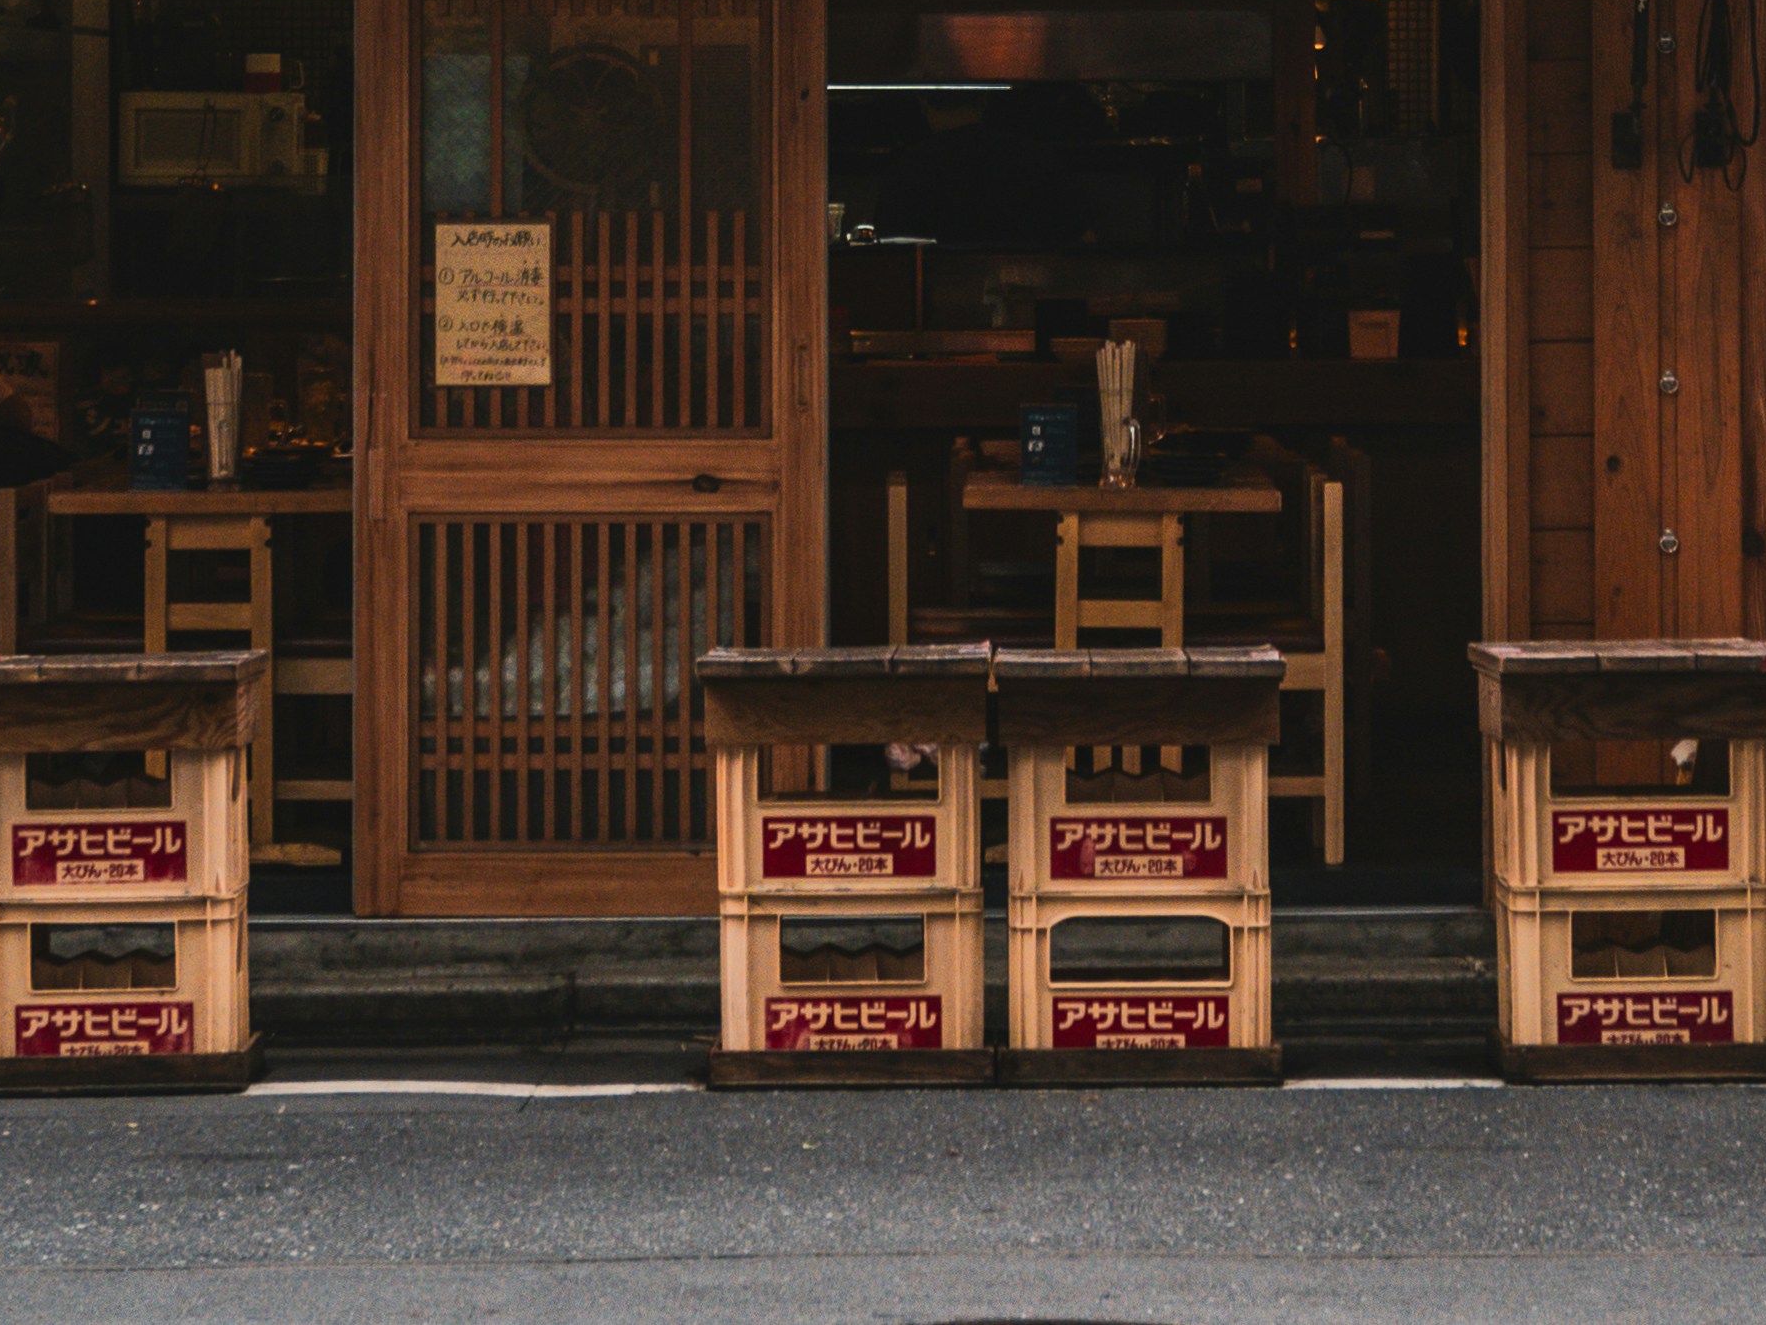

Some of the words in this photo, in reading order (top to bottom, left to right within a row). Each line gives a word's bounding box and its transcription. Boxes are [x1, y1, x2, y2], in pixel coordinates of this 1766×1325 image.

[17, 826, 182, 856] アサヒビール
[767, 820, 932, 850] アサヒビール
[1054, 820, 1223, 850] アサヒビール
[1556, 813, 1724, 844] アサヒビール
[20, 1008, 190, 1038] アサヒビール
[769, 1001, 938, 1030] アサヒビール
[1057, 1000, 1226, 1030] アサヒビール
[1561, 996, 1729, 1026] アサヒビール
